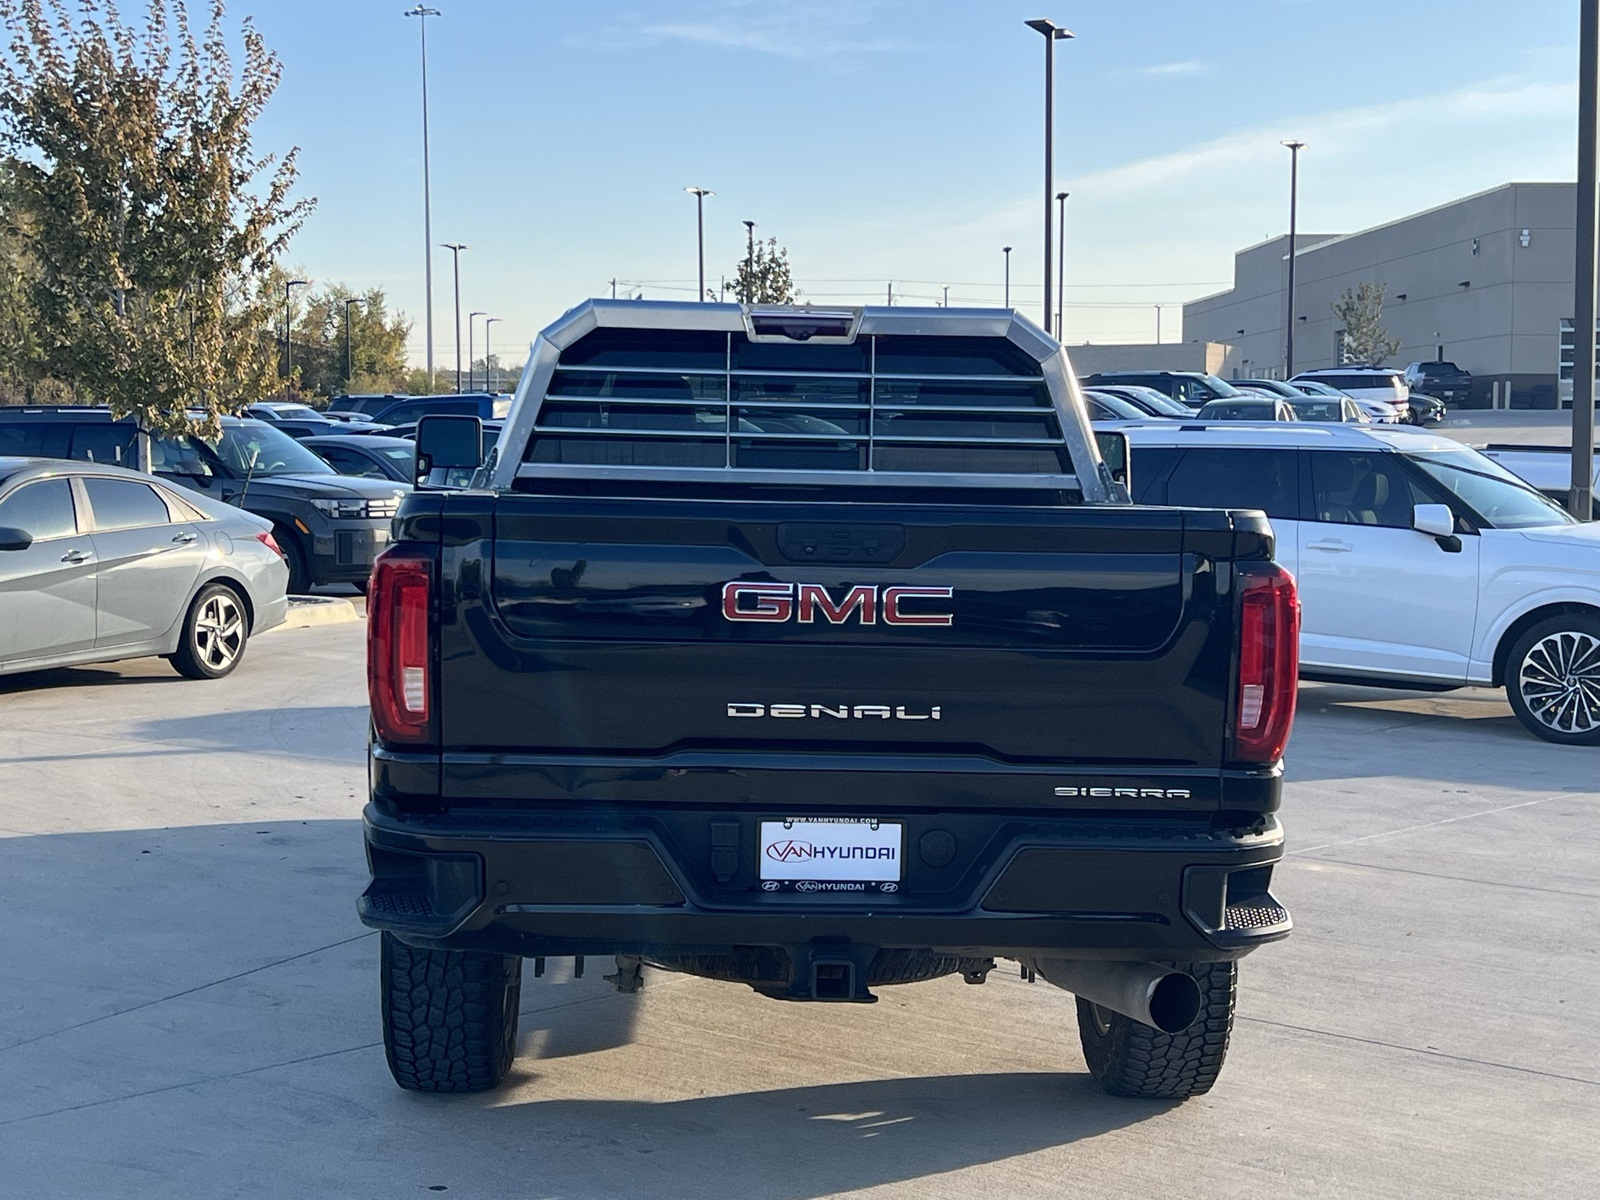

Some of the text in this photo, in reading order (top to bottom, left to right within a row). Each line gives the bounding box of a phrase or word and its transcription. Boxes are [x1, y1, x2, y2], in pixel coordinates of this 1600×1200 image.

[722, 581, 954, 627] GMC
[727, 702, 941, 721] DENALI
[1054, 786, 1191, 799] SIERRA
